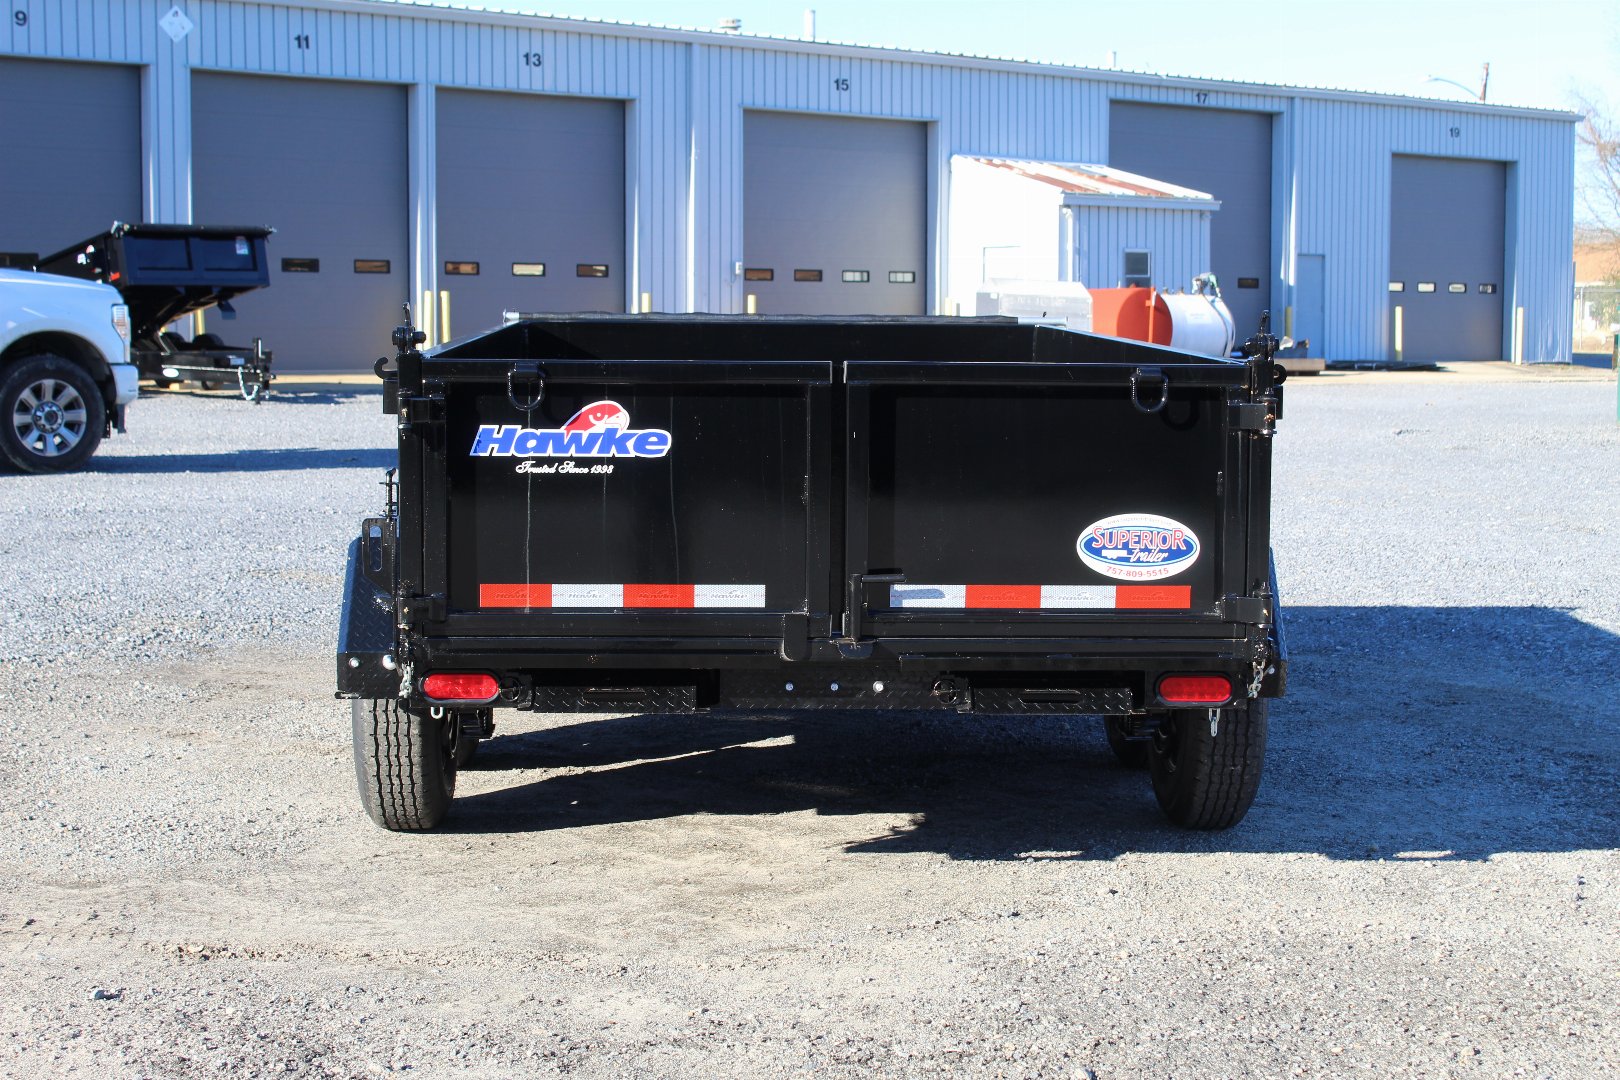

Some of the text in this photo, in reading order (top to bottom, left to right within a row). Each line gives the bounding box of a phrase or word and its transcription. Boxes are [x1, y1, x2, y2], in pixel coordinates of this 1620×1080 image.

[14, 9, 27, 27] 9
[294, 35, 310, 49] 11
[523, 52, 541, 67] 13
[833, 79, 849, 92] 15
[1195, 92, 1208, 104] 17
[1449, 127, 1460, 138] 19
[470, 424, 672, 458] Hawke
[515, 461, 614, 474] Trusted Since 1998
[1092, 527, 1186, 550] SUPERIOR
[1130, 547, 1168, 562] trailer
[1106, 565, 1169, 578] 757-809-5515
